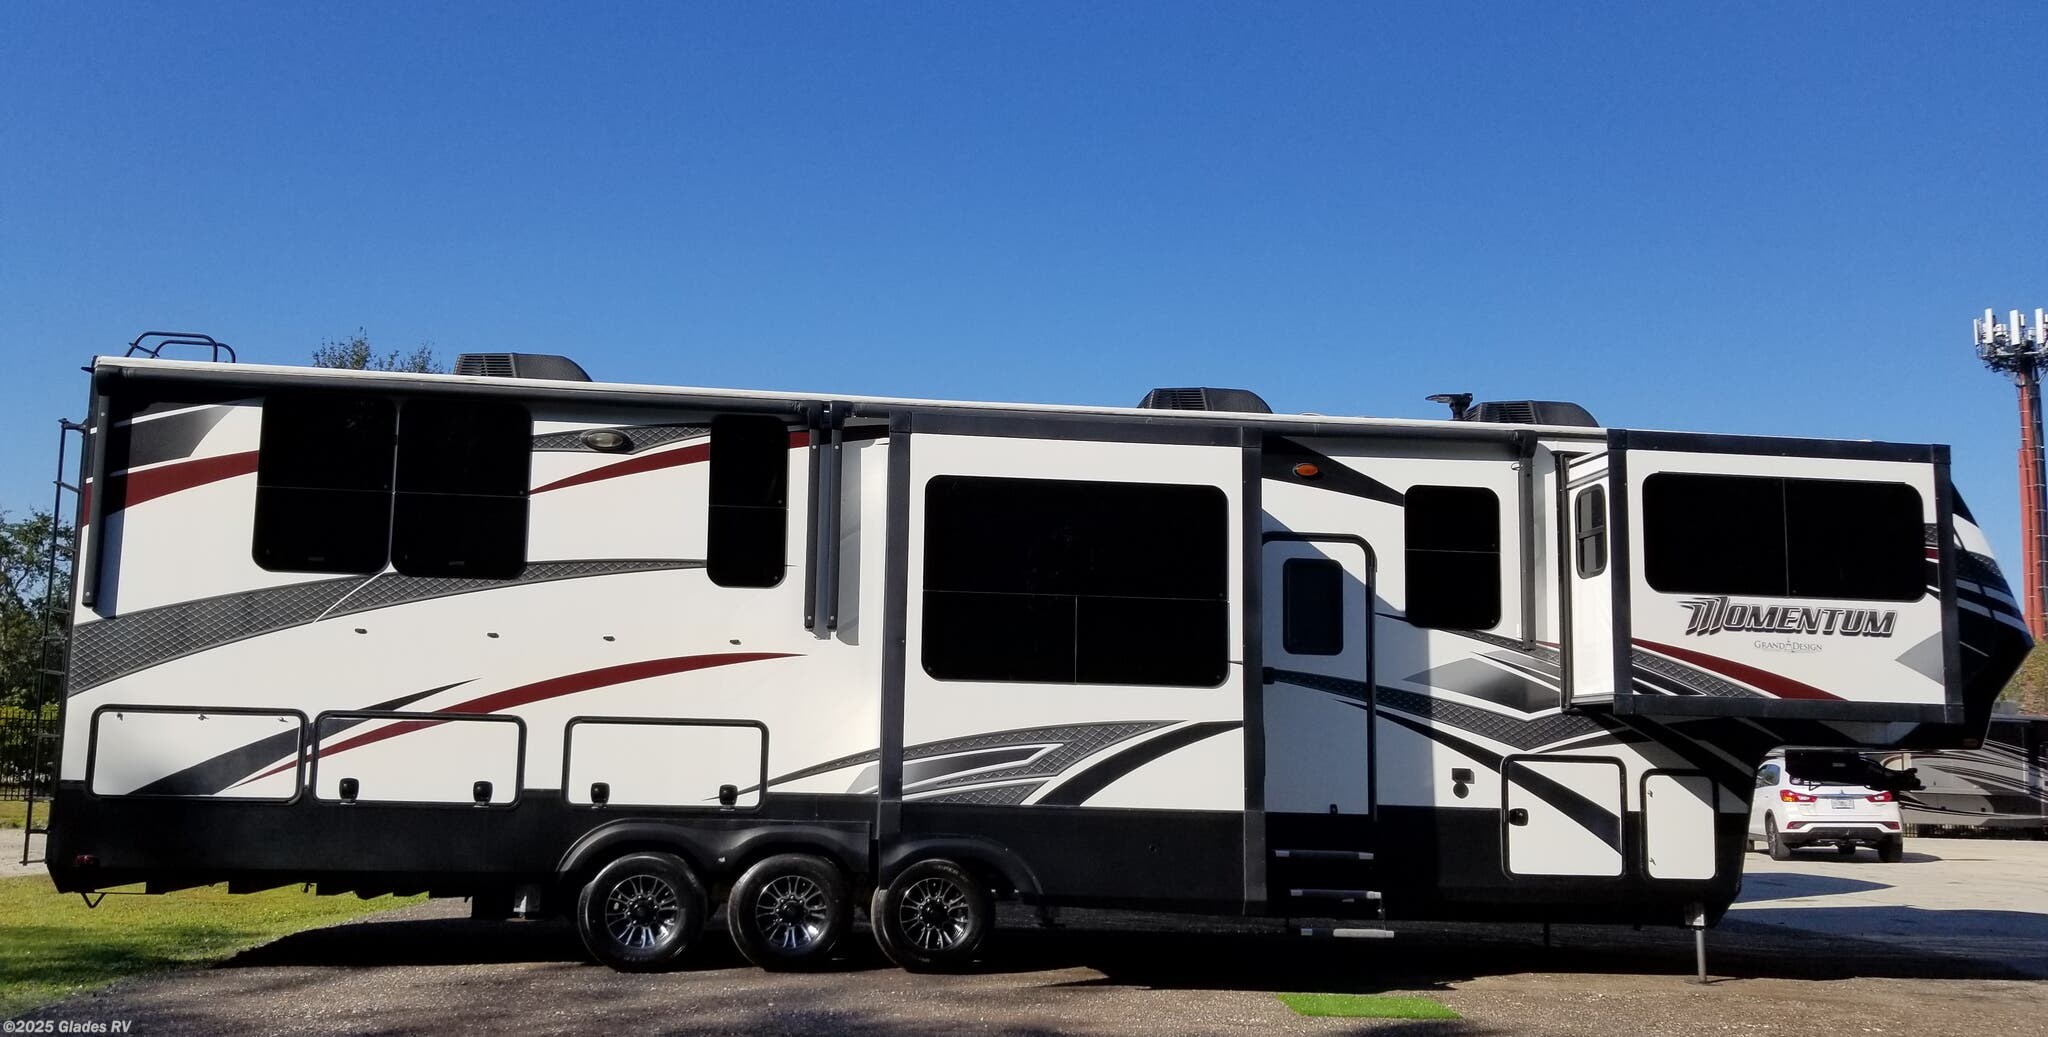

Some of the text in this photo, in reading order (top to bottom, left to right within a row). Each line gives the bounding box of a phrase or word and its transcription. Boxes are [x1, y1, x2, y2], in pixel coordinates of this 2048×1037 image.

[1678, 596, 1897, 638] MOMENTUM
[1754, 640, 1823, 652] GRAND DESIGN
